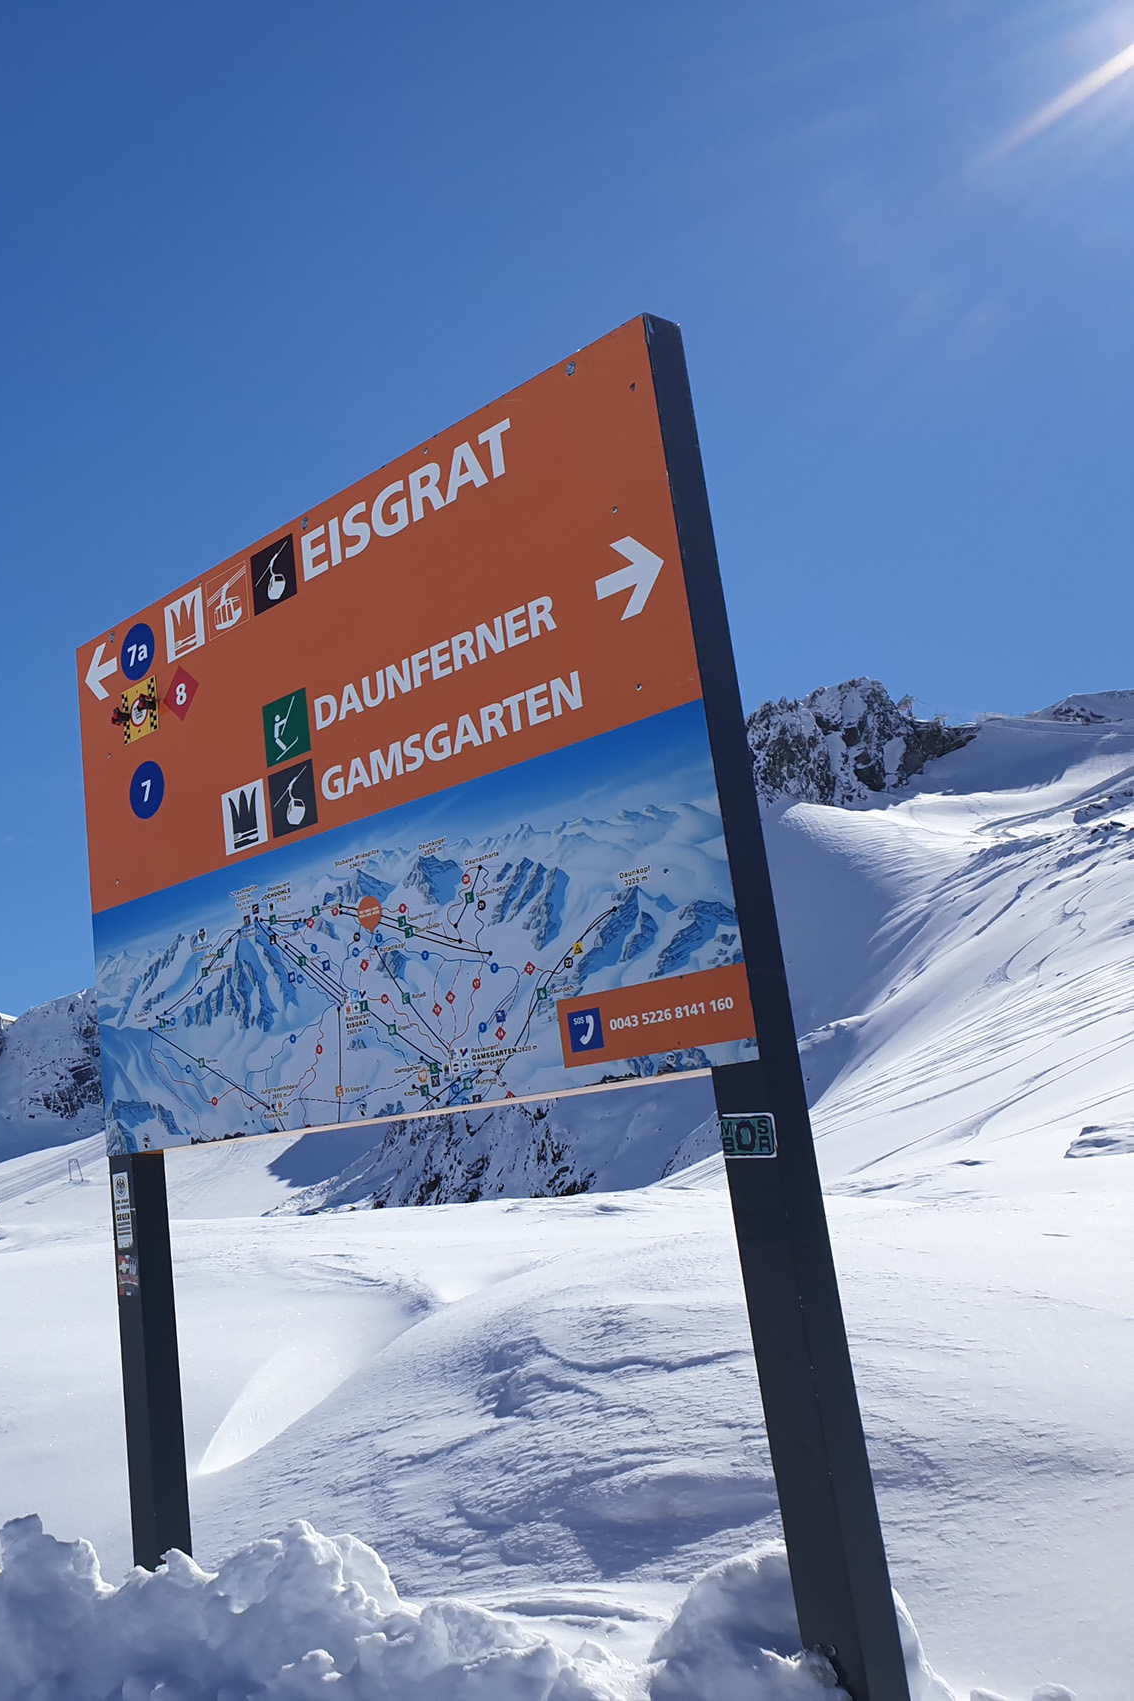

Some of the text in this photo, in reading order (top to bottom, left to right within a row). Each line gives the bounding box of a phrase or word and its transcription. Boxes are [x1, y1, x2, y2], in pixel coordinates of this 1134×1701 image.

[301, 417, 511, 582] EISGRAT
[127, 643, 148, 667] 7a
[314, 596, 557, 731] DAUNFERNER
[175, 682, 187, 706] 8
[321, 670, 583, 800] GAMSGARTEN
[141, 779, 152, 803] 7
[418, 837, 446, 850] Daunkogel
[464, 851, 500, 866] Daunscharte
[619, 865, 651, 879] Daunkopf
[624, 877, 640, 886] 3225
[573, 1016, 585, 1026] SOS
[609, 996, 734, 1031] 0043 5226 8141 160
[346, 1020, 370, 1030] EISGRAT
[471, 1048, 518, 1061] GAMSGARTEN
